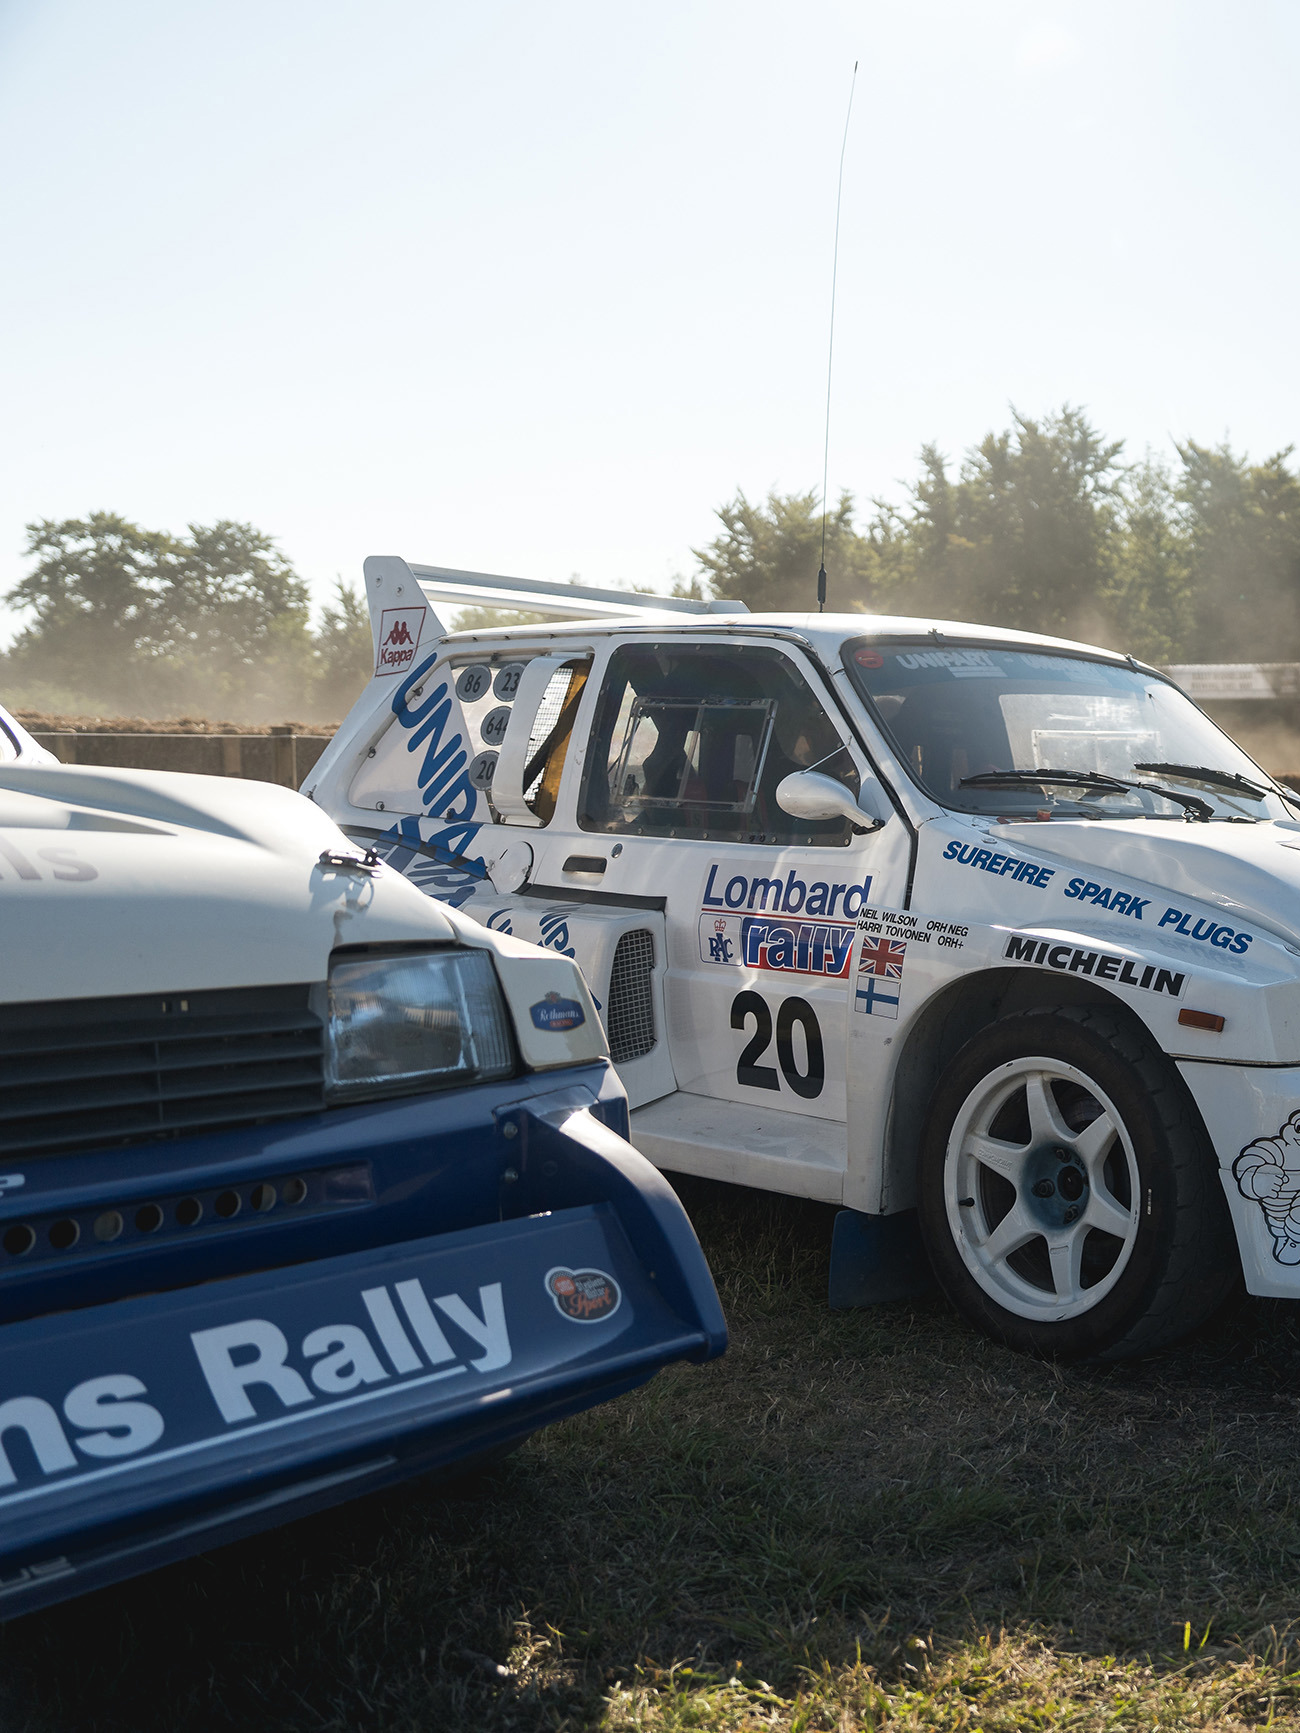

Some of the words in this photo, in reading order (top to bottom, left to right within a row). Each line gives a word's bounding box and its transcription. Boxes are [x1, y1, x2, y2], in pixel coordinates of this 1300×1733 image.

[380, 647, 414, 667] Kappa
[896, 651, 994, 670] UNIPART
[464, 674, 482, 693] 86
[702, 864, 873, 919] Lombard
[942, 840, 1055, 889] SUREFIRE
[1064, 877, 1152, 920] SPARK
[1158, 907, 1253, 954] PLUGS
[857, 920, 882, 934] HARRI
[886, 925, 931, 943] TOIVONEN
[937, 935, 964, 949] ORH+
[860, 907, 879, 920] NEIL
[881, 911, 918, 927] WILSON
[926, 920, 948, 933] ORH
[948, 924, 969, 937] NEG
[708, 932, 734, 962] RAC
[746, 924, 856, 975] rally
[1005, 936, 1187, 997] MICHELIN
[730, 989, 826, 1101] 20
[190, 1277, 513, 1426] Rally
